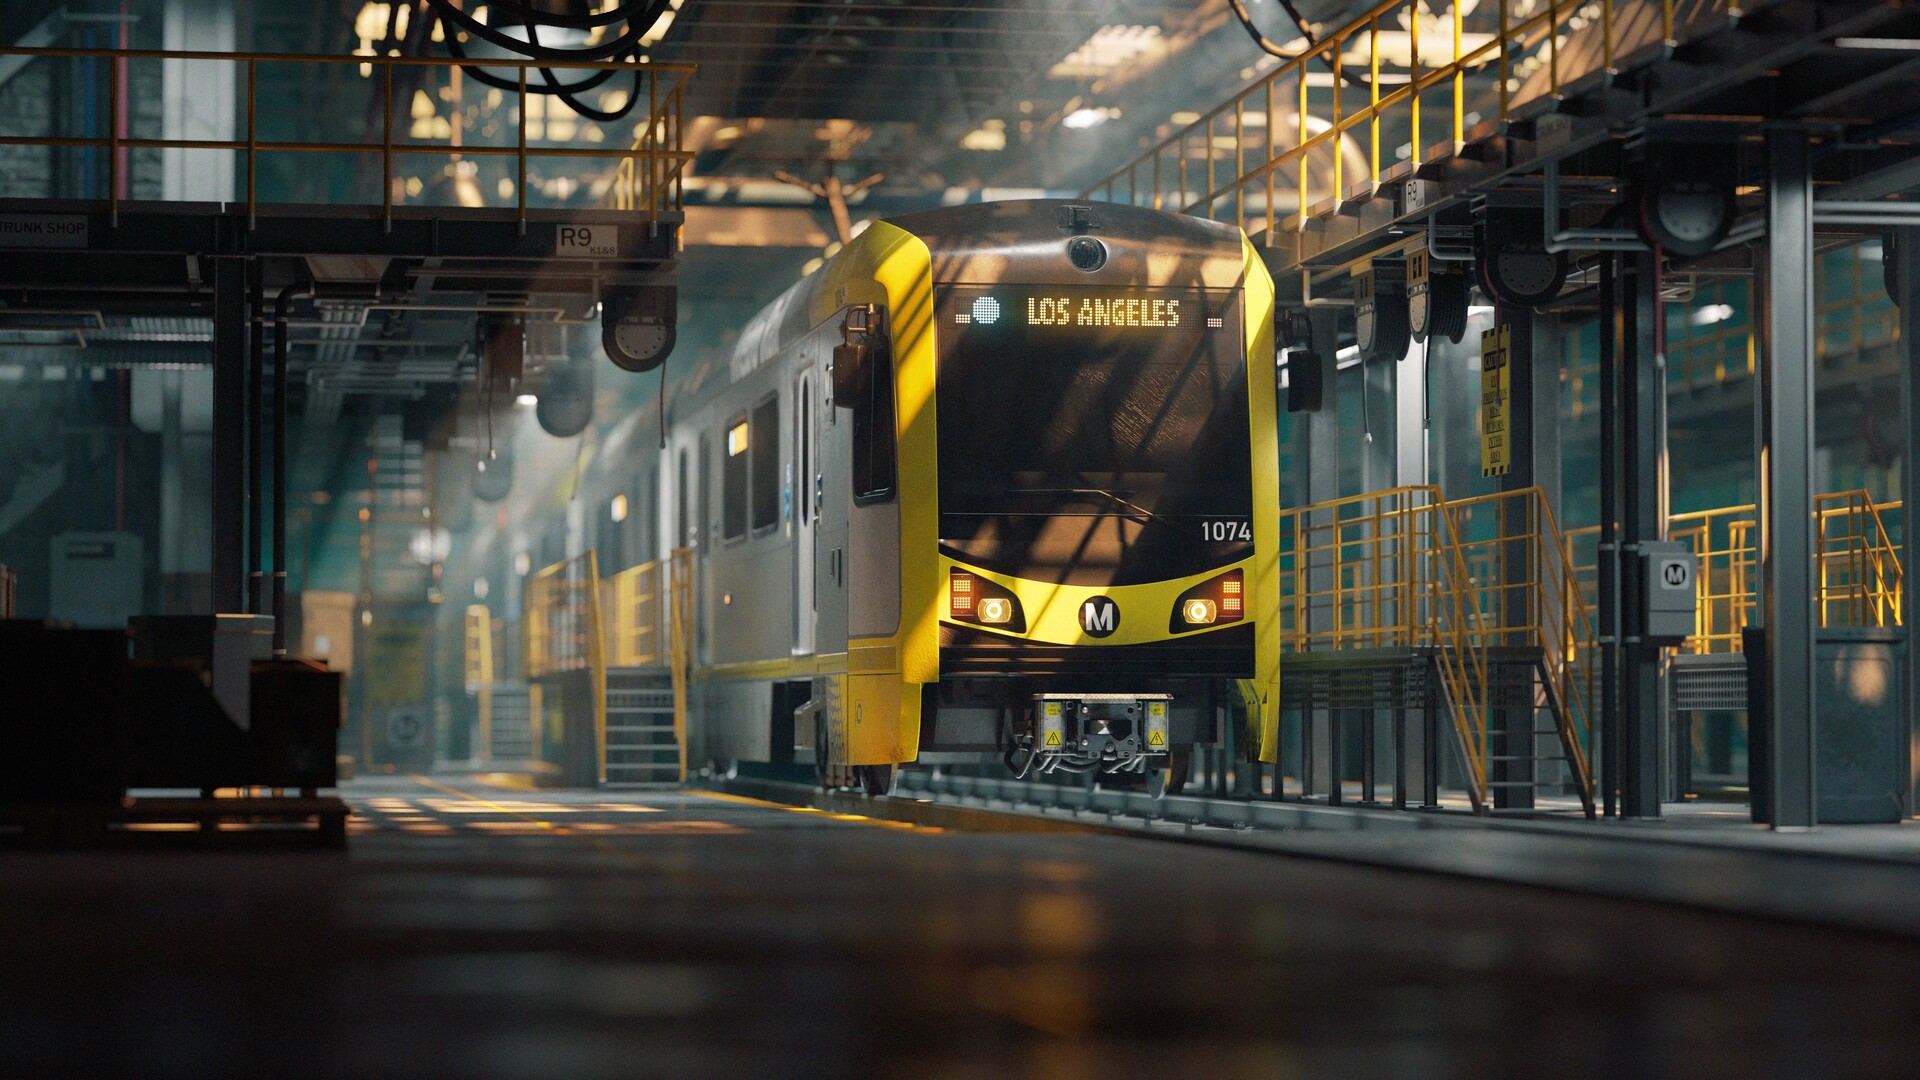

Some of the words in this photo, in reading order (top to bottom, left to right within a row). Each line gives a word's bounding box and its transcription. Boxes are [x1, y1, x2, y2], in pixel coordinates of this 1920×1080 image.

[1407, 181, 1417, 203] R9
[47, 222, 85, 234] SHOP
[561, 227, 592, 247] R9
[1027, 297, 1070, 325] LOS
[1077, 298, 1180, 327] ANGELES
[1201, 521, 1252, 541] 1074
[1666, 565, 1684, 585] M
[1084, 601, 1115, 632] M
